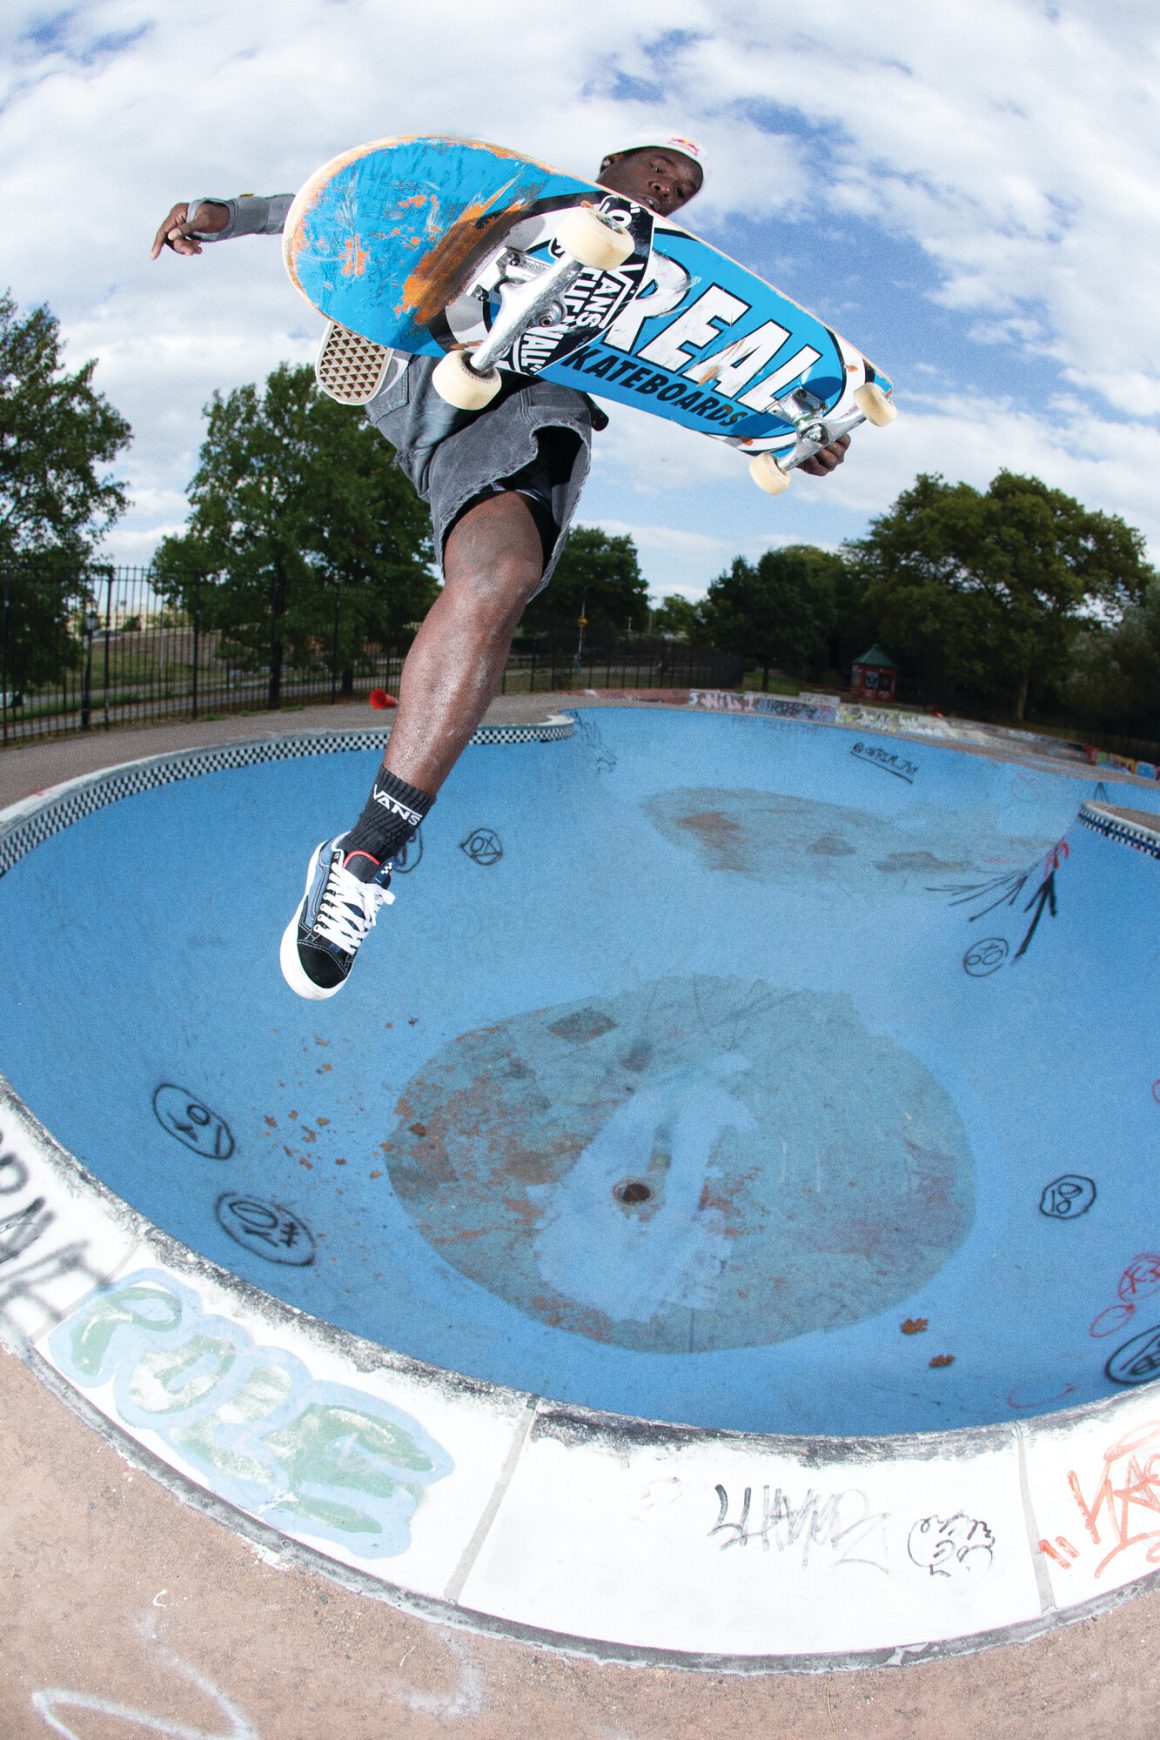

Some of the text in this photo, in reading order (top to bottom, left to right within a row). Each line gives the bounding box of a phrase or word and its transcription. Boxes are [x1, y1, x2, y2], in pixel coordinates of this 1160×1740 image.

[576, 263, 646, 330] VANS
[603, 250, 824, 415] REAL
[561, 345, 748, 429] KATEBOARDS
[372, 783, 424, 827] VANS
